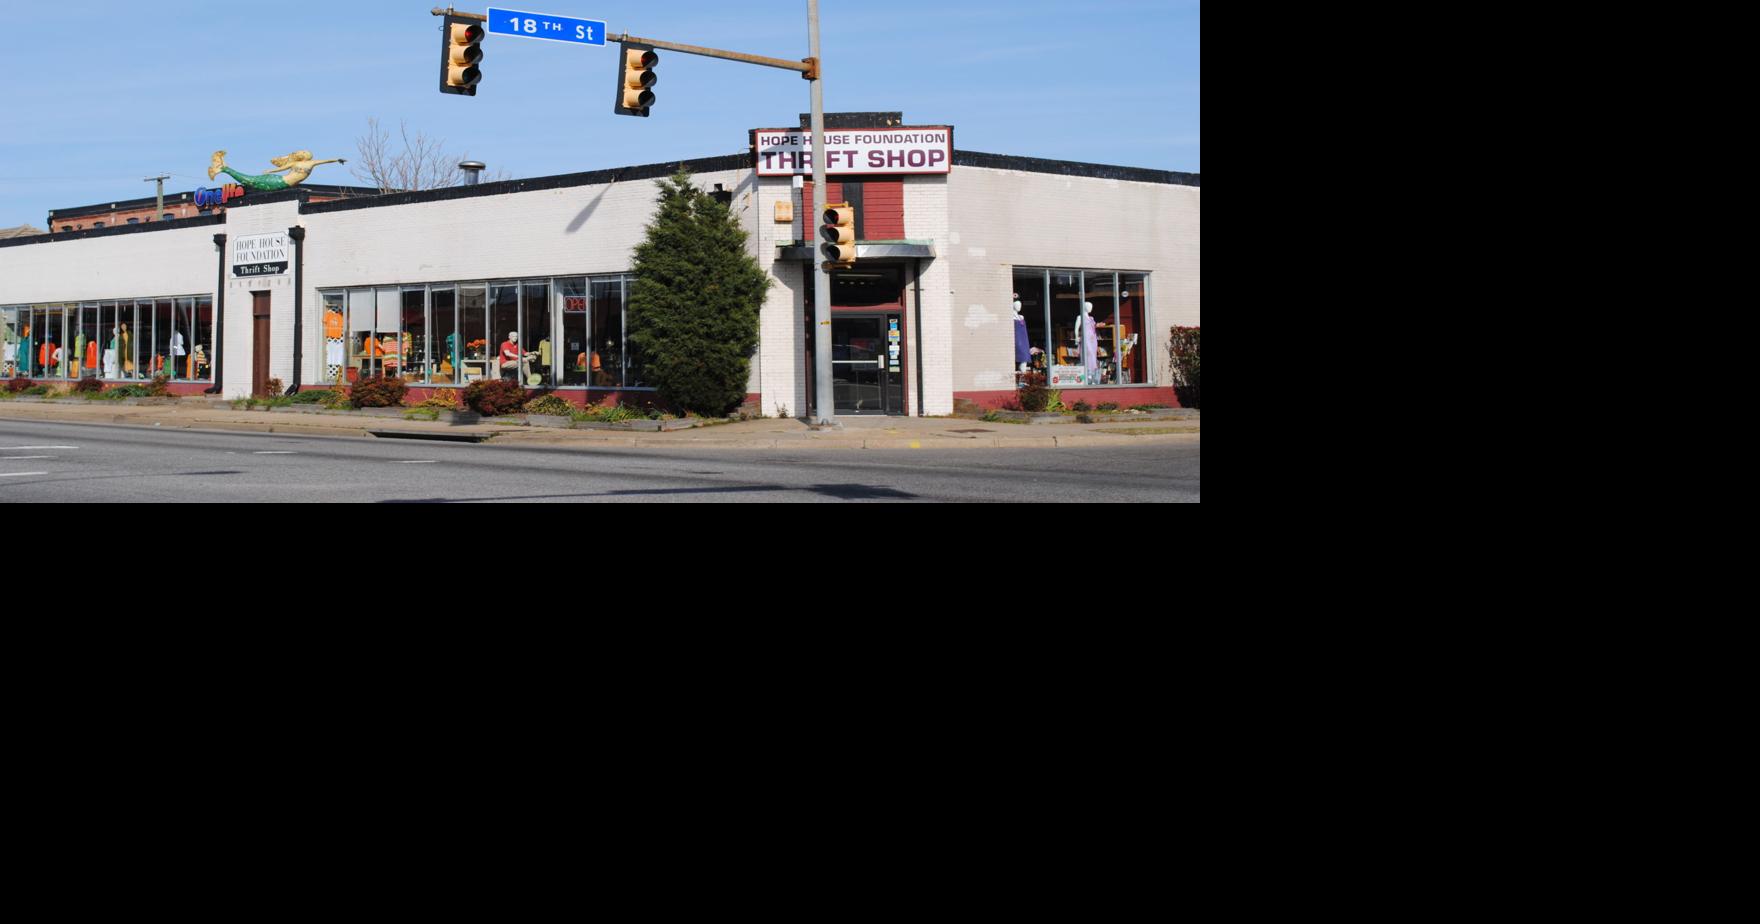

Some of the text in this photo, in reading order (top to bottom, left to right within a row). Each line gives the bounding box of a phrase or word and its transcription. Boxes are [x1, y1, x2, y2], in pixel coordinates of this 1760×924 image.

[575, 25, 594, 41] St
[761, 133, 945, 146] HOPE HUSE FOUNDATION
[761, 149, 945, 169] THRFT SHOP
[236, 239, 256, 251] HOPE
[236, 249, 285, 262] FOUNDATION
[240, 264, 280, 274] Thrift Shop
[566, 297, 586, 311] OPE
